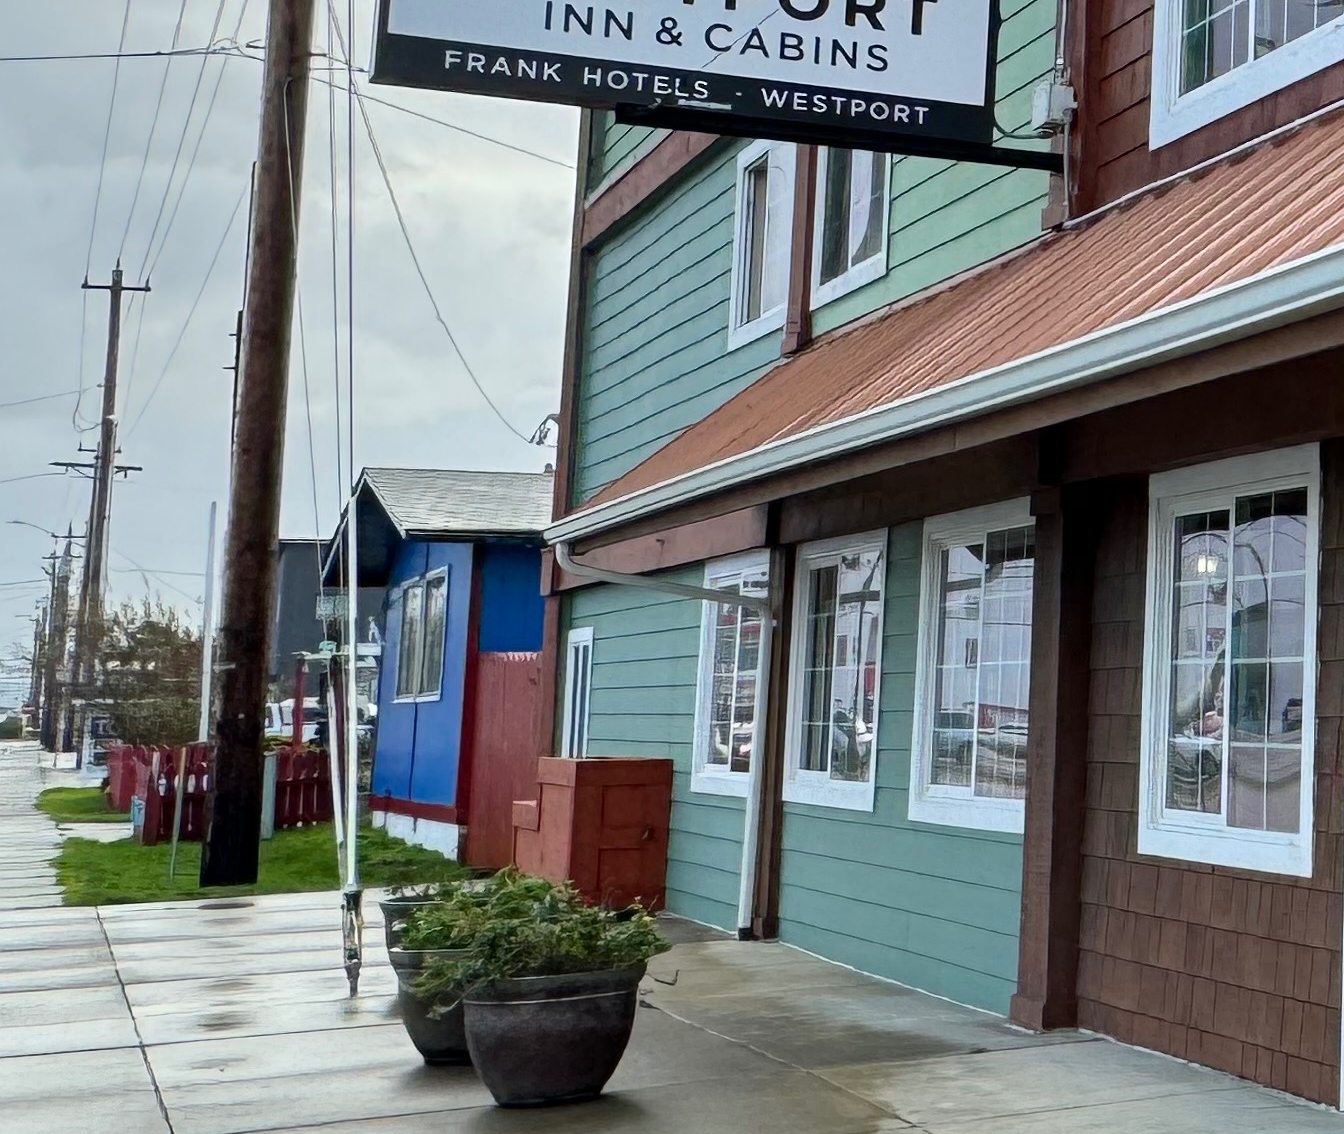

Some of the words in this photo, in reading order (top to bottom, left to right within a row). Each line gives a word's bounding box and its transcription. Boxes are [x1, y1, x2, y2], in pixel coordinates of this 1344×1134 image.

[544, 0, 634, 42] INN
[655, 16, 683, 47] &
[704, 22, 890, 73] CABINS
[444, 49, 563, 83] FRANK
[582, 66, 710, 100] HOTELS
[760, 87, 930, 126] WESTPORT
